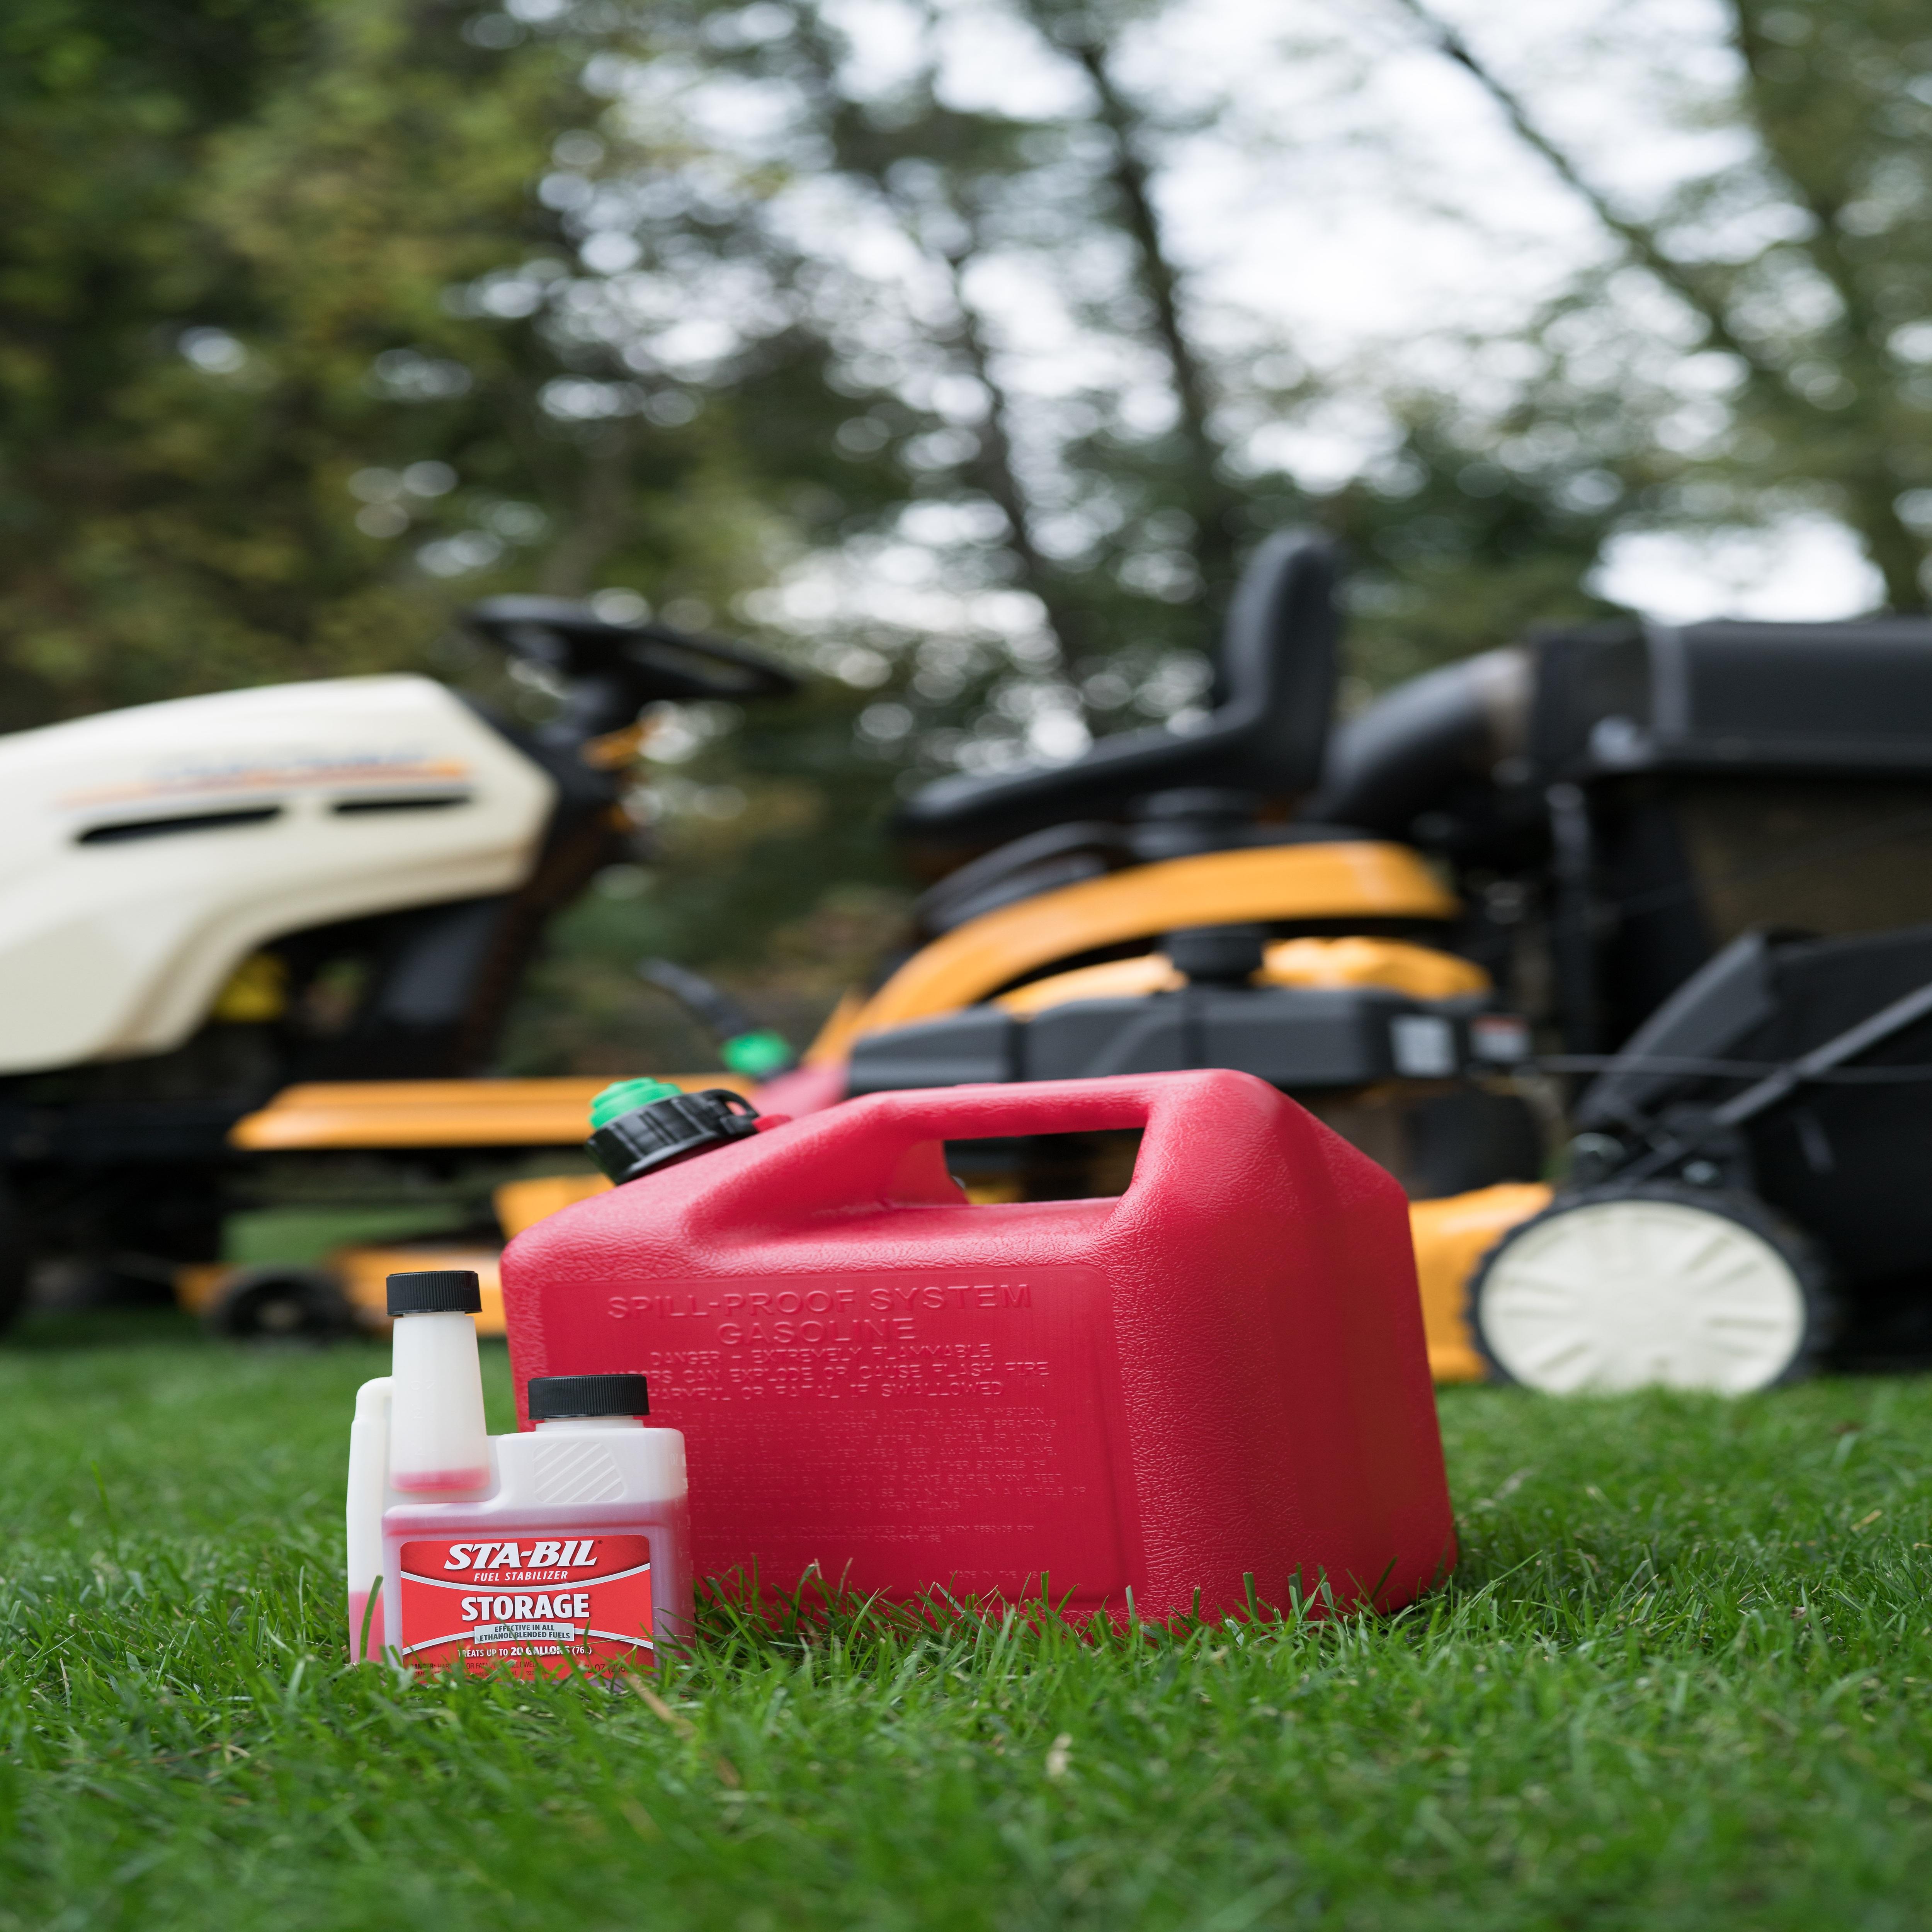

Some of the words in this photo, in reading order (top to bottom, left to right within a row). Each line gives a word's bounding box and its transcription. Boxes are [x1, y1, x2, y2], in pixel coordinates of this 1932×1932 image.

[607, 1289, 854, 1318] SPILL-PROOF
[867, 1284, 1028, 1311] SYSTEM
[716, 1318, 915, 1344] GASOLINE
[649, 1351, 720, 1366] DANGER
[749, 1346, 862, 1364] EXTREMELY
[871, 1343, 993, 1361] FLAMMABLE
[681, 1368, 718, 1383] CAN
[728, 1367, 813, 1383] EXPLODE
[824, 1366, 848, 1379] OR
[857, 1364, 923, 1379] CAUSE
[931, 1362, 995, 1378] FLASH
[1005, 1361, 1050, 1376] FIRE
[739, 1386, 765, 1400] OR
[774, 1384, 841, 1399] FATAL
[849, 1384, 869, 1398] IF
[881, 1381, 1004, 1397] SWALLOWED
[444, 1540, 598, 1570] STA-BIL
[474, 1572, 500, 1582] FUEL
[504, 1570, 568, 1581] STABILIZER
[461, 1593, 590, 1621] STORAGE
[494, 1624, 530, 1633] EFFECTIVE
[457, 1649, 484, 1657] TREATS
[510, 1646, 524, 1656] 20
[572, 1646, 592, 1655] (76)
